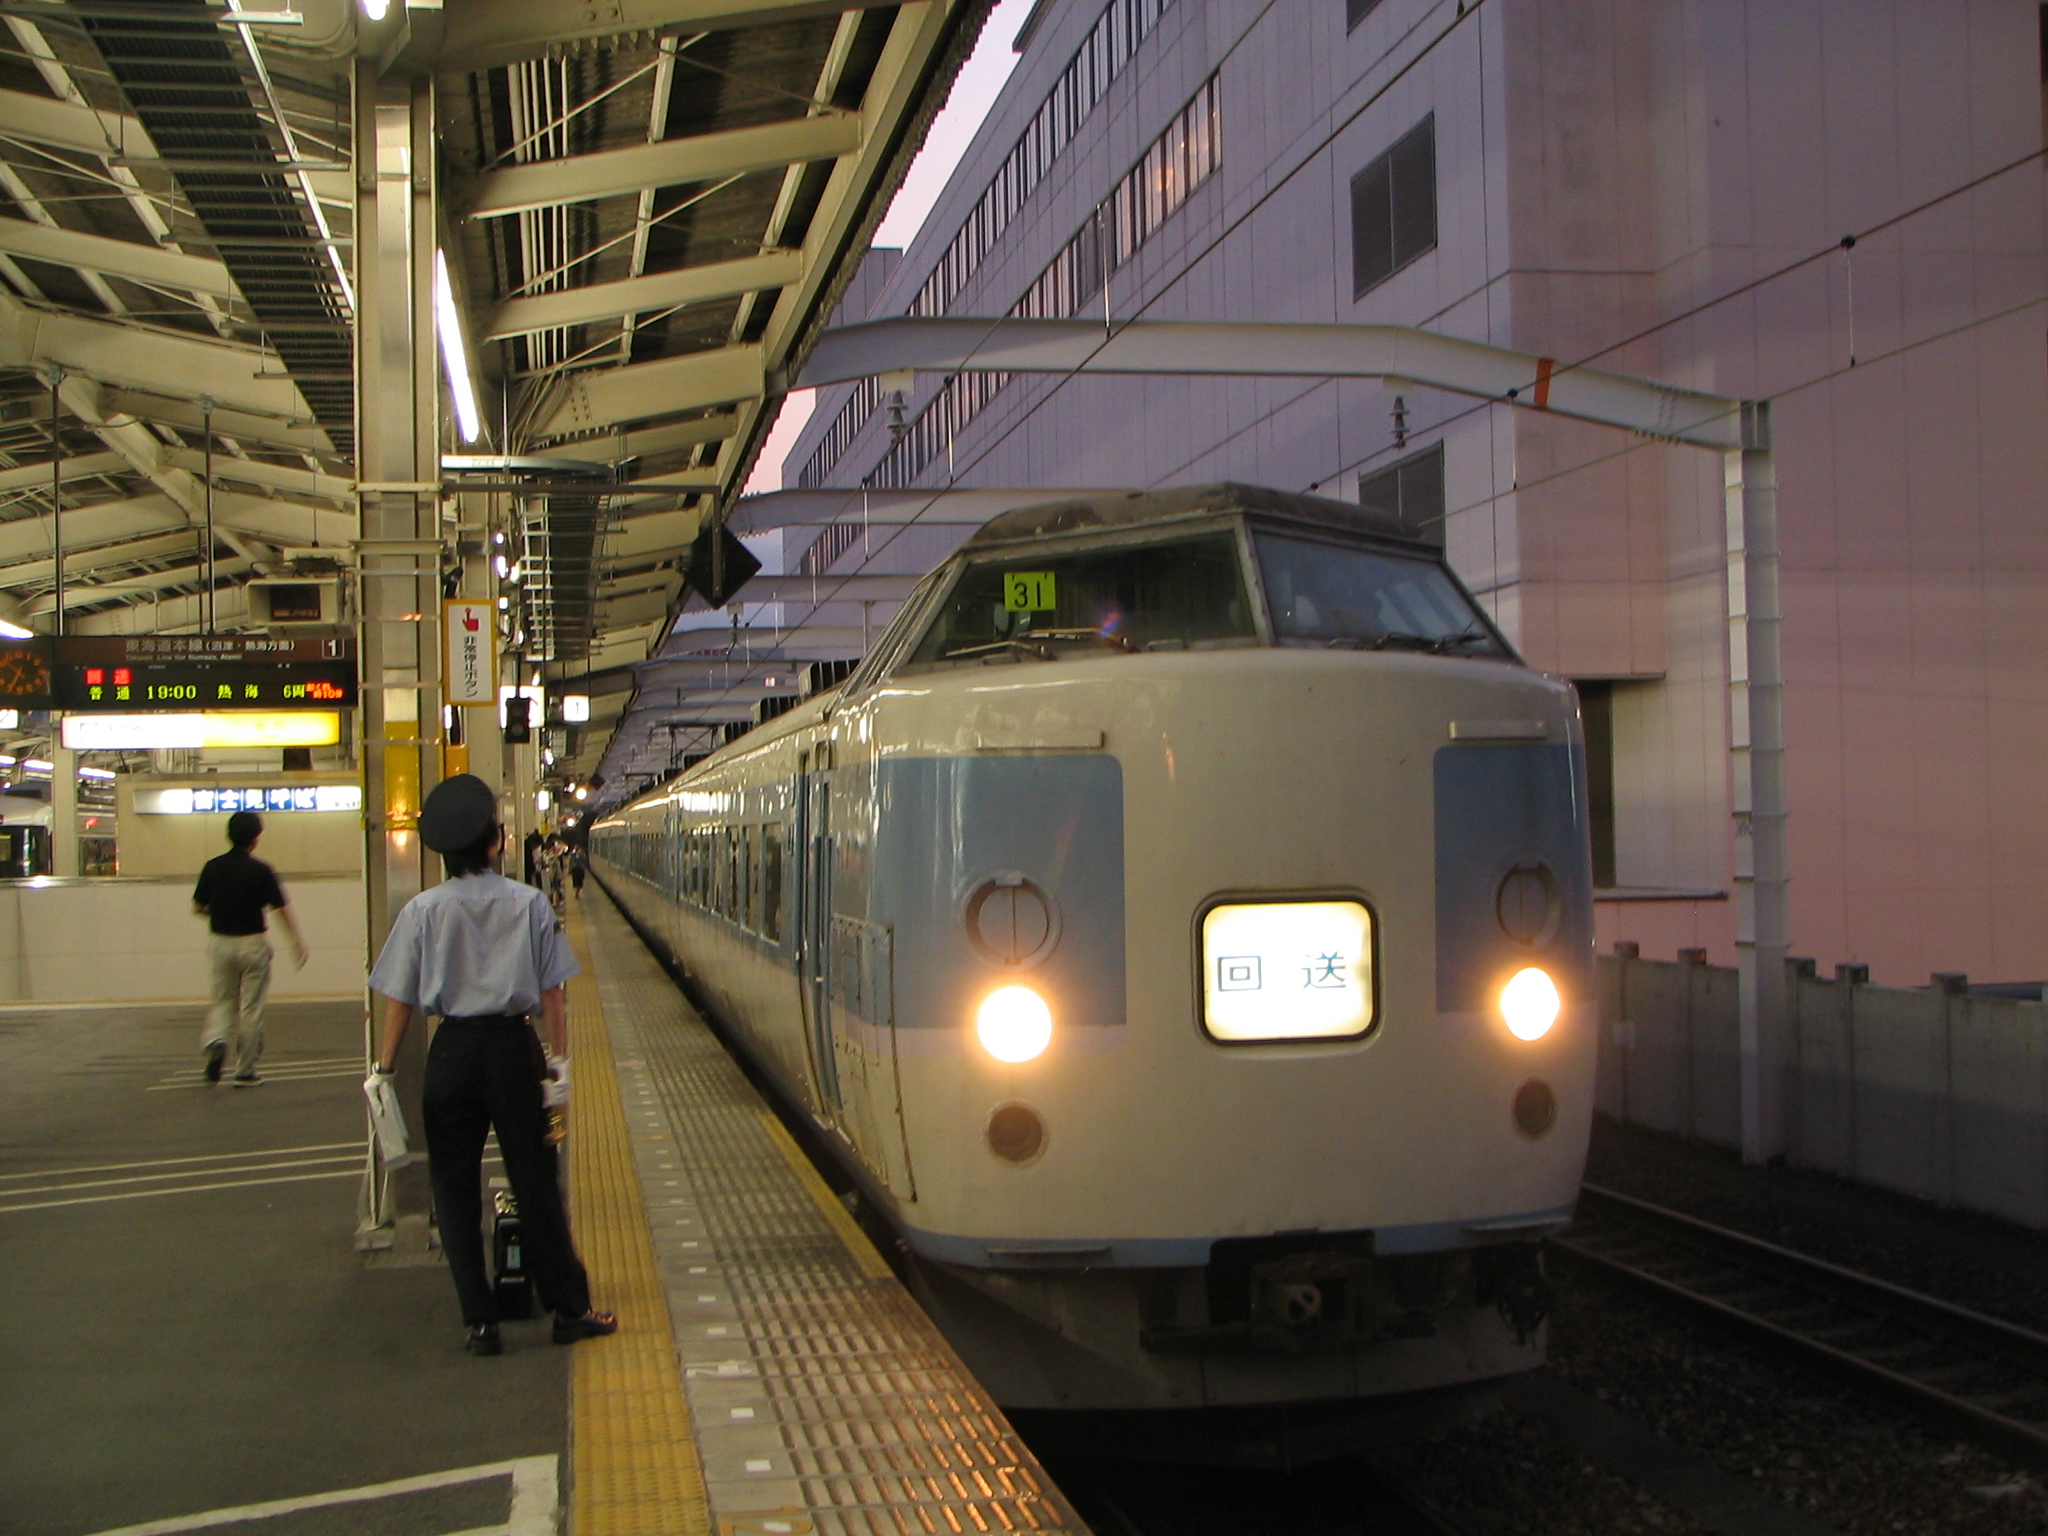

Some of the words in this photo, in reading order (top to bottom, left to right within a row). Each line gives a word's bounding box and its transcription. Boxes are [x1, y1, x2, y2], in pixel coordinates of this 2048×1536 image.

[1014, 581, 1041, 608] 31
[327, 639, 337, 657] 1
[89, 685, 130, 701] 普通
[146, 684, 197, 700] 19:00
[1217, 951, 1347, 992] 回送
